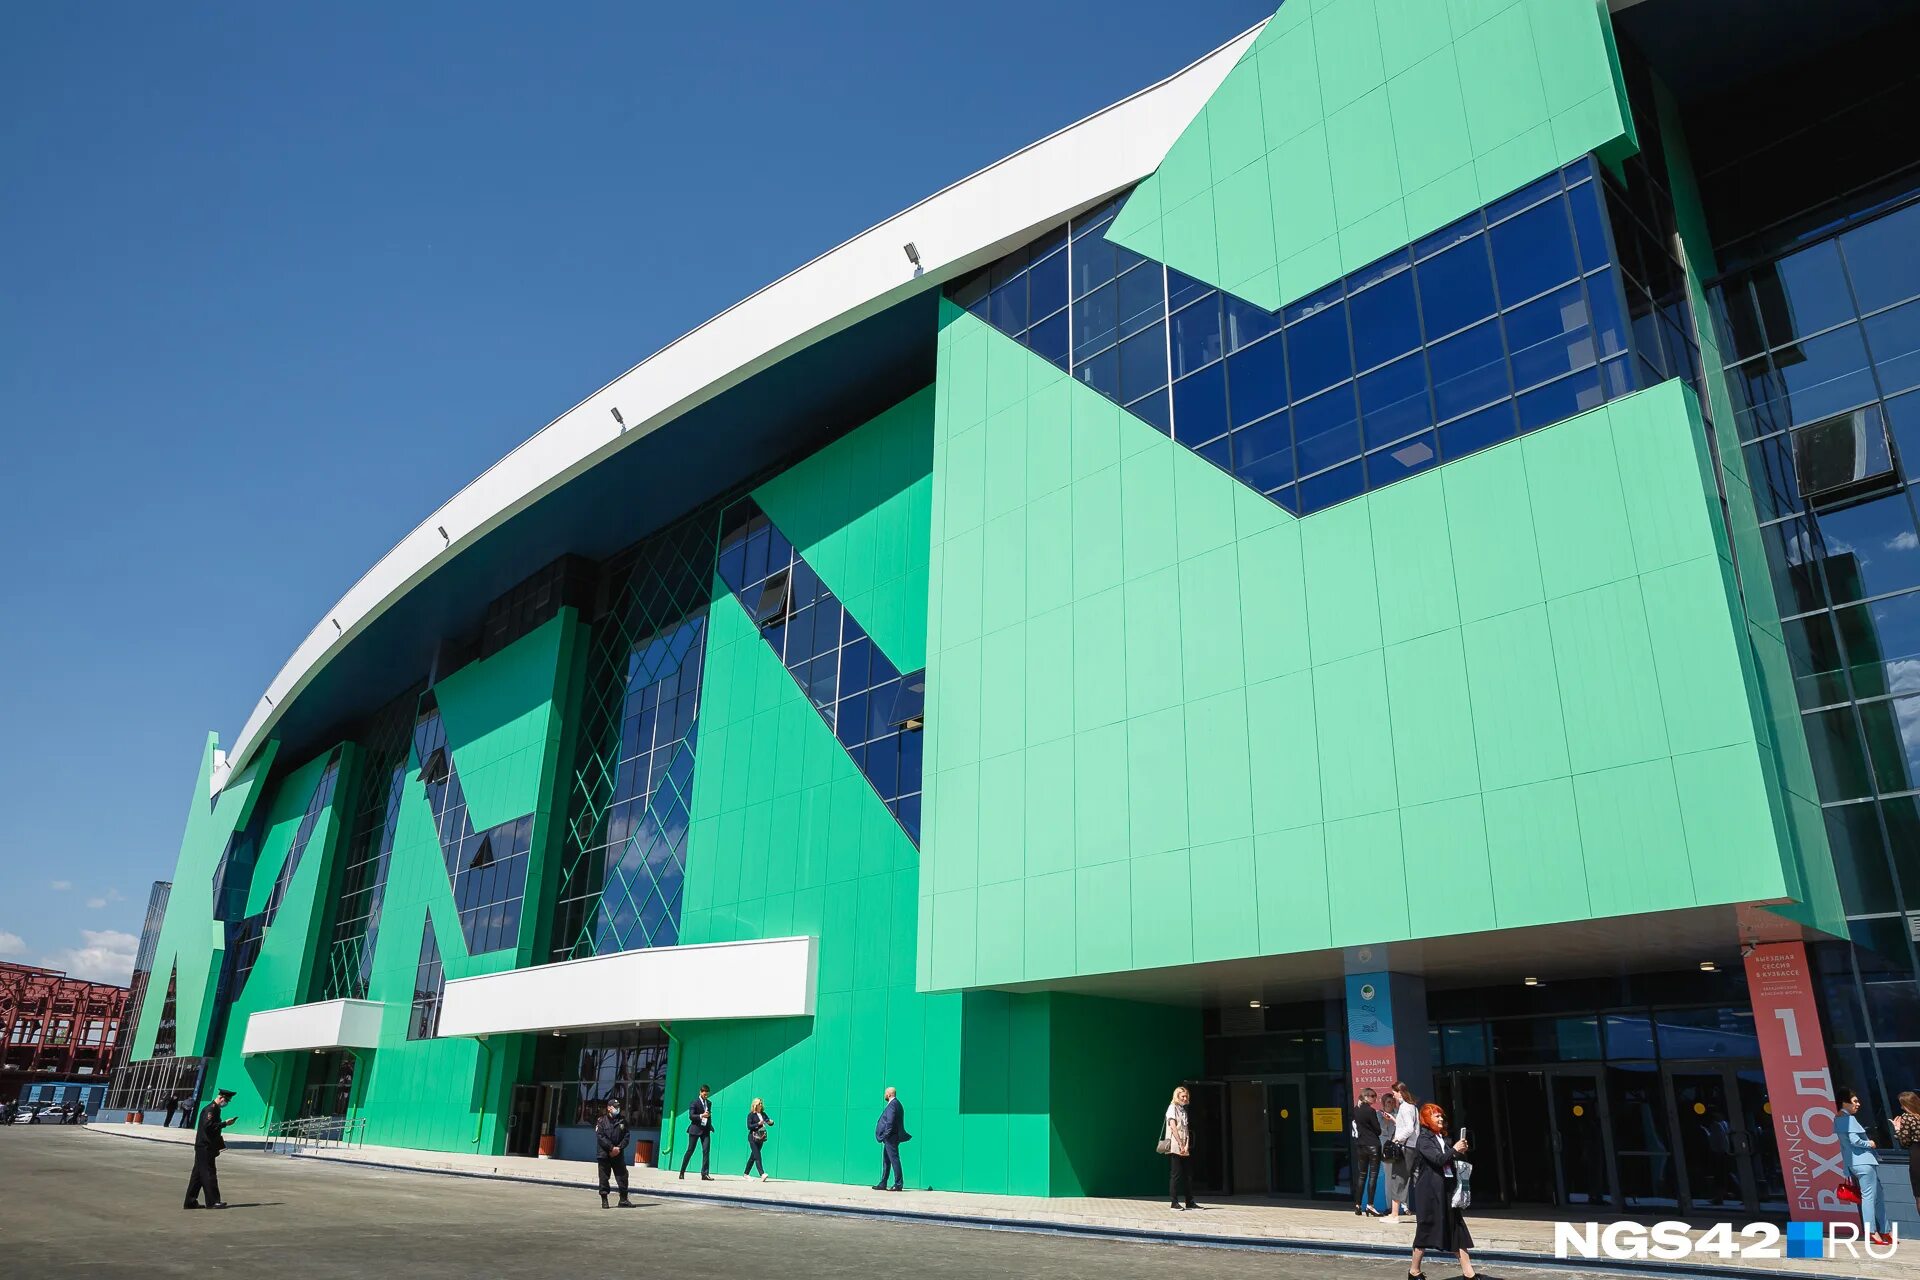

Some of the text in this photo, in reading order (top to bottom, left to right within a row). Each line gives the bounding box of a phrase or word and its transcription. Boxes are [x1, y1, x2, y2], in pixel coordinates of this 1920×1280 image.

[1755, 954, 1795, 962] ВЫЕЗДНАЯ
[1774, 1008, 1803, 1057] 1
[1782, 1114, 1815, 1210] ENTRANCE
